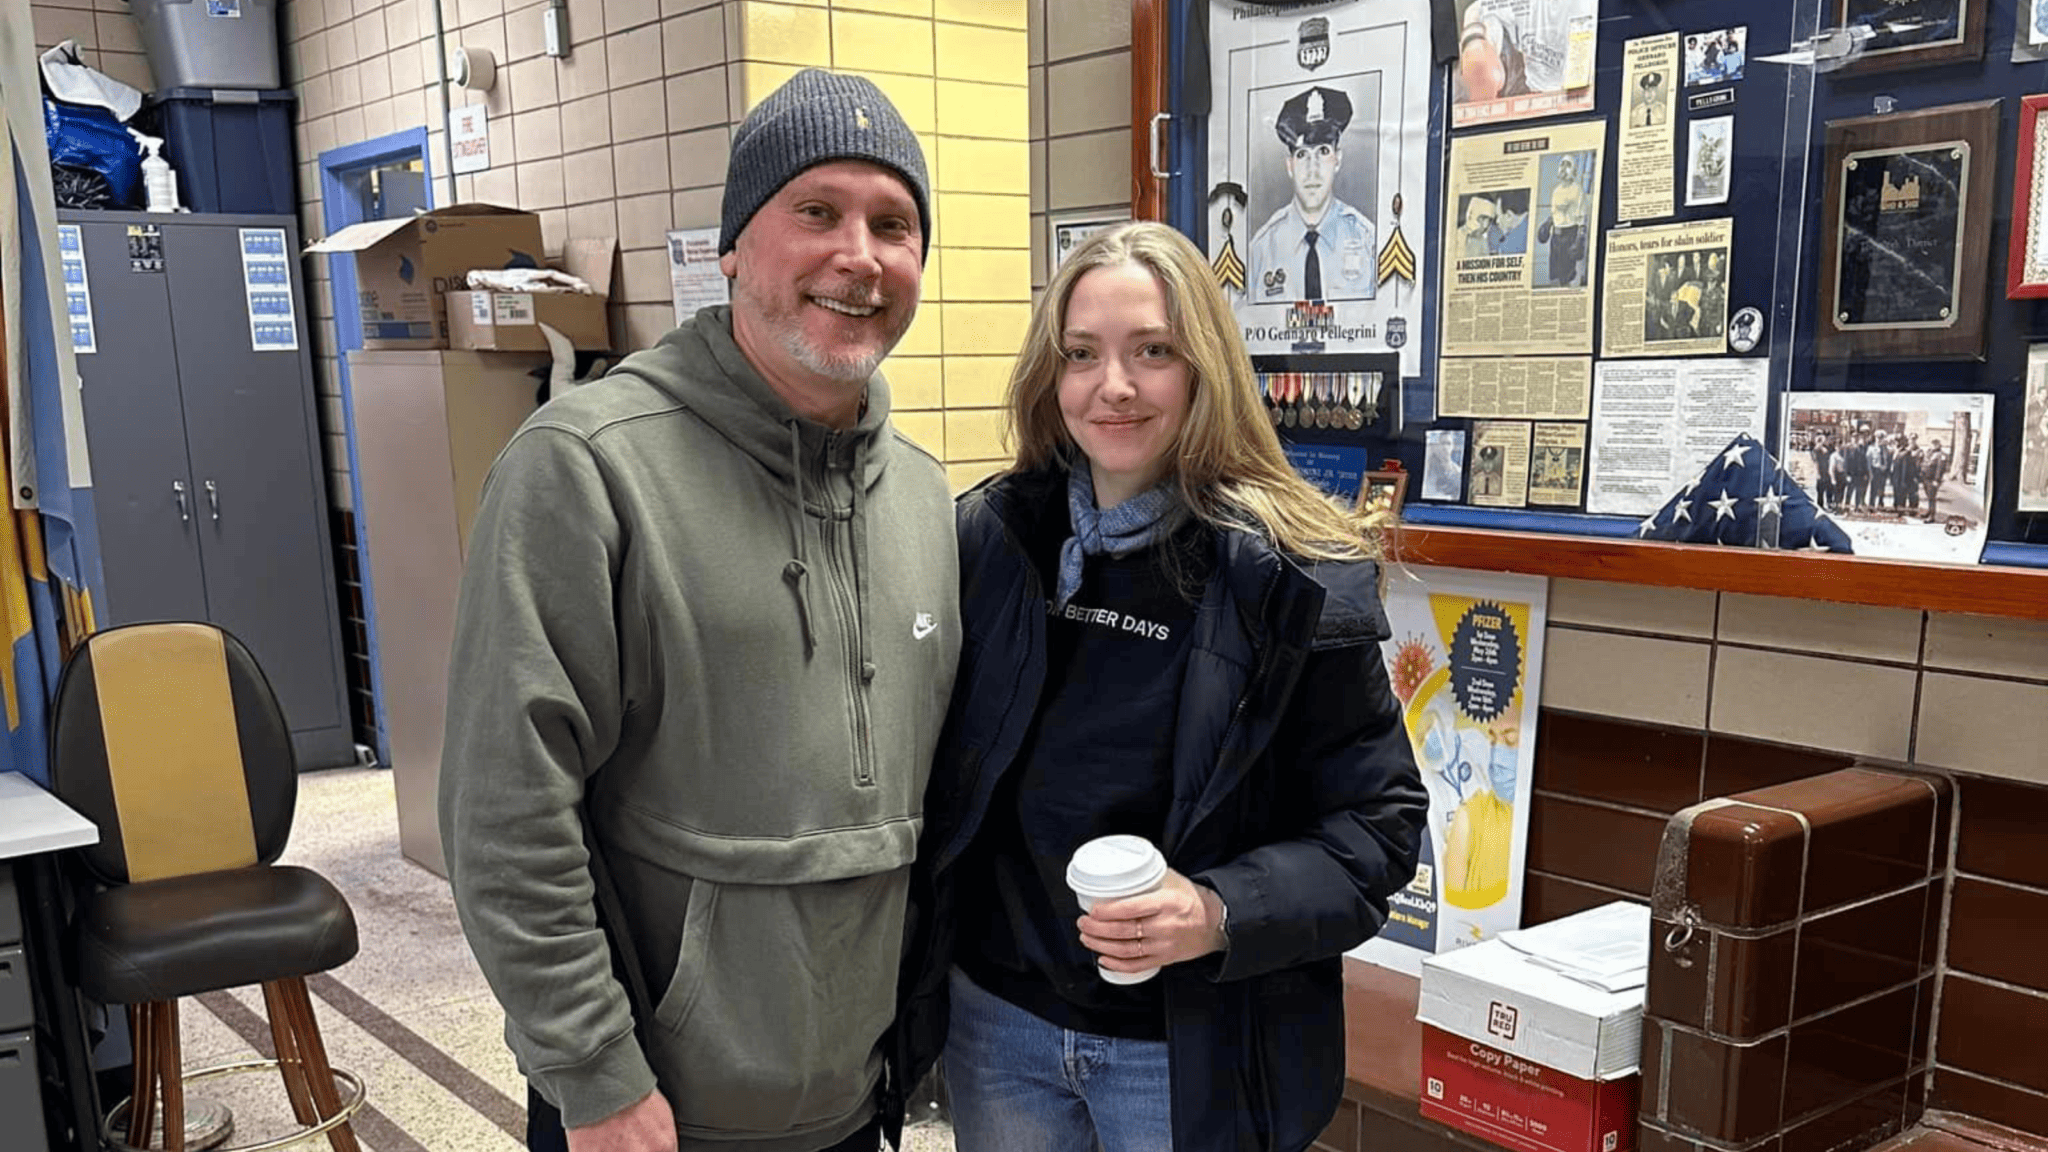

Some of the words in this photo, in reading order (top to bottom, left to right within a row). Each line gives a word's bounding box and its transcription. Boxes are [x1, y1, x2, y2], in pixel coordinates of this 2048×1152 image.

[1609, 241, 1638, 253] Honors,
[1640, 240, 1659, 250] tears
[1660, 237, 1673, 247] for
[1674, 234, 1694, 246] slain
[1695, 232, 1725, 244] soldier
[1462, 259, 1491, 270] MISSION
[1491, 257, 1505, 269] FOR
[1458, 273, 1476, 284] THEN
[1476, 272, 1489, 283] HIS
[1489, 270, 1522, 282] COUNTRY
[1245, 327, 1266, 342] P/O
[1268, 325, 1317, 341] Gennaro
[1320, 324, 1377, 343] Pellegrini
[1064, 604, 1119, 628] BETTER
[1122, 614, 1170, 641] DAYS
[1472, 614, 1502, 630] PFIZER
[1495, 1010, 1513, 1023] TRU
[1493, 1018, 1511, 1031] RED
[1470, 1043, 1502, 1066] Copy
[1503, 1053, 1541, 1077] Paper
[1430, 1080, 1442, 1093] 10
[1605, 1134, 1615, 1145] 10
